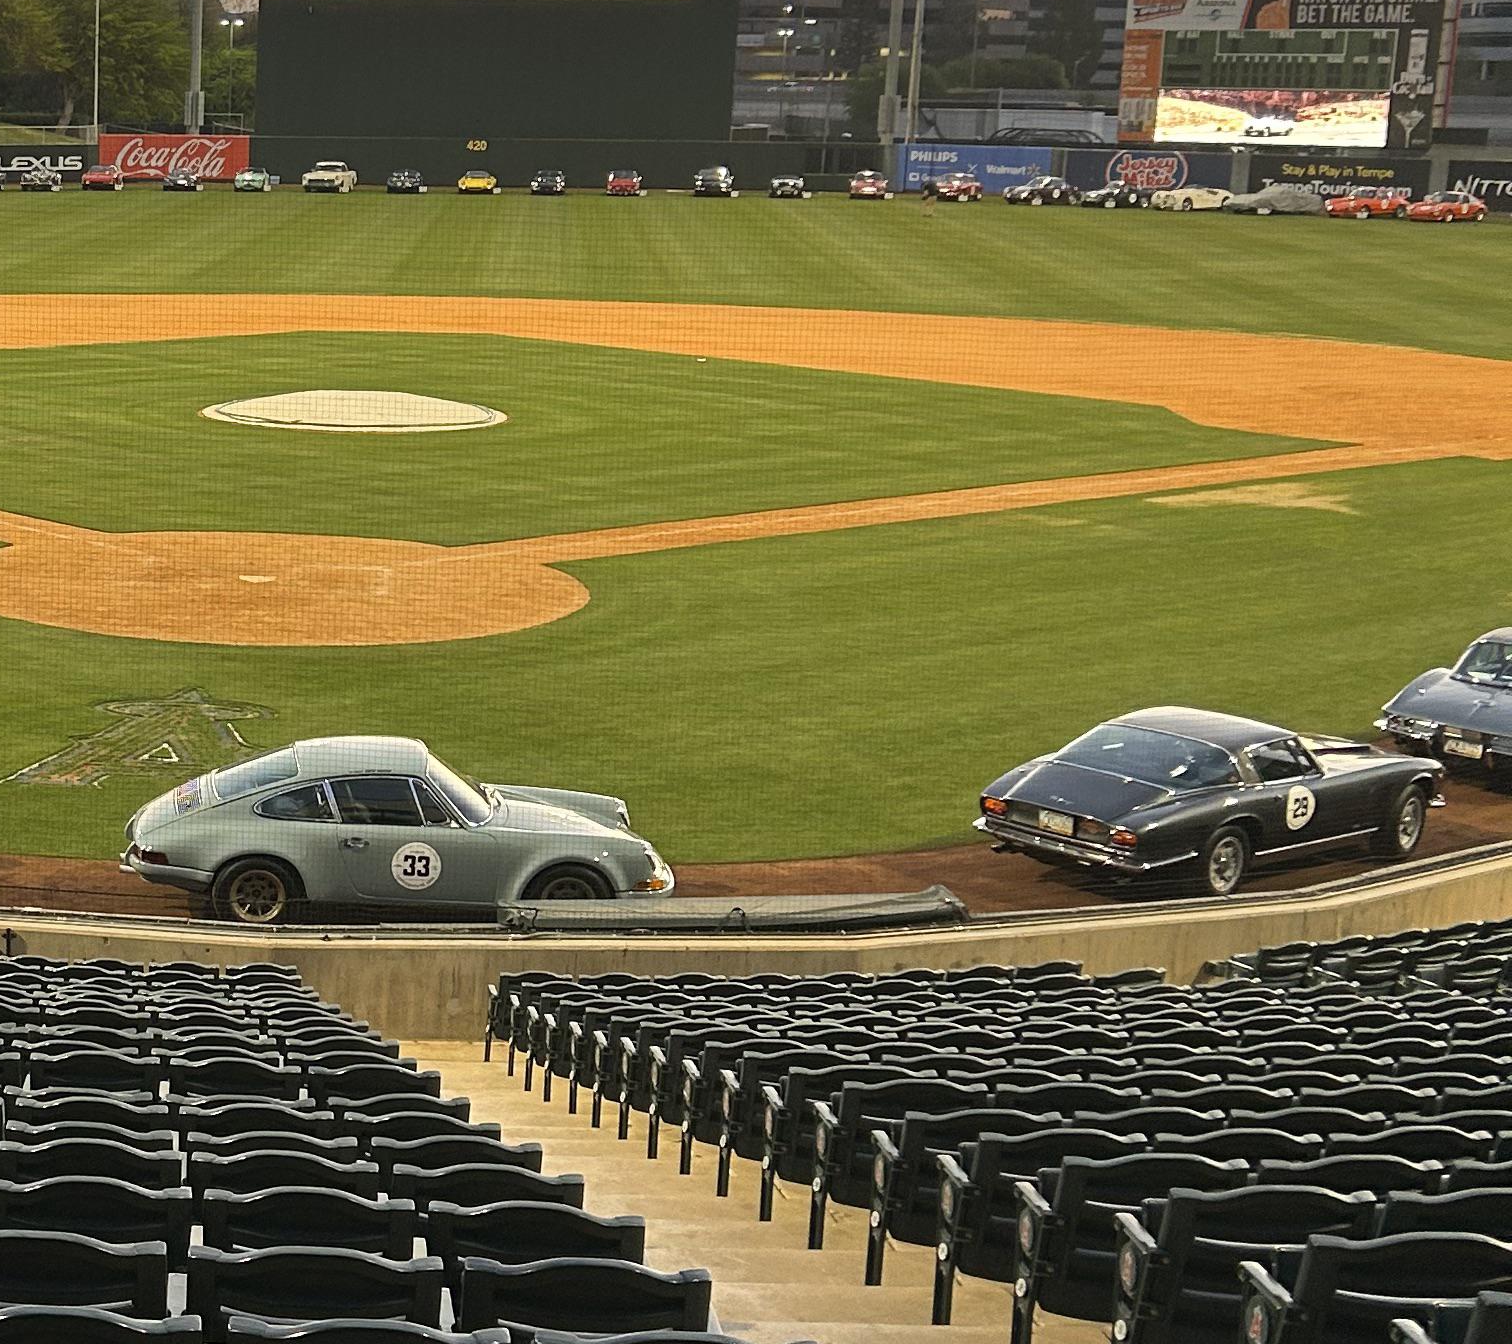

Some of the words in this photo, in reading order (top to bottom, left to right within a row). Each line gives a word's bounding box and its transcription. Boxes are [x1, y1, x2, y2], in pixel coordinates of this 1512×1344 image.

[1297, 4, 1327, 23] BET
[1332, 4, 1360, 23] THE
[1364, 4, 1415, 23] GAME.
[466, 140, 488, 151] 420
[910, 150, 958, 163] PHILIPS
[1117, 154, 1178, 174] Jersey
[986, 164, 1026, 176] Walmart
[1281, 163, 1305, 177] Stay
[1307, 164, 1317, 176] &
[1319, 164, 1339, 179] Play
[1342, 166, 1354, 177] in
[1356, 166, 1395, 180] Tempe
[403, 854, 430, 877] 33
